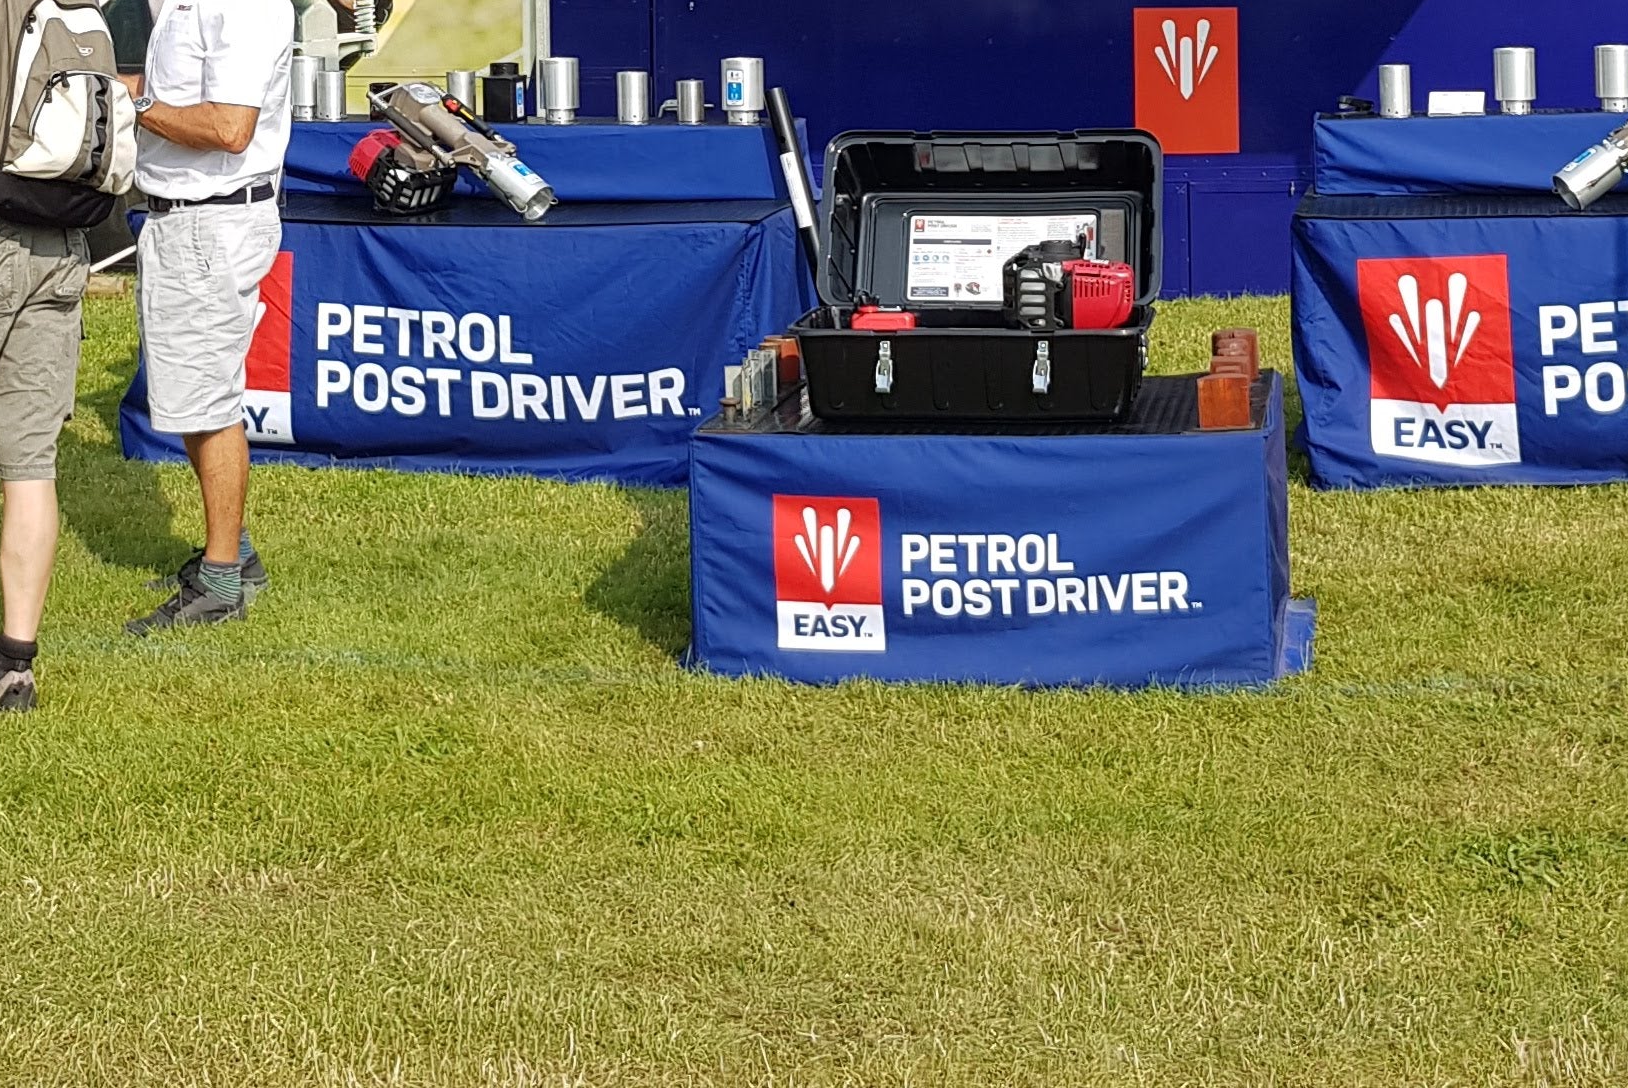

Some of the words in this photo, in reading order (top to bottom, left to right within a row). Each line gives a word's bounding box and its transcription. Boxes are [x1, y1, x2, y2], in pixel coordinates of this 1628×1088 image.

[317, 302, 533, 364] PETROL
[316, 360, 461, 417] POST
[471, 367, 686, 421] DRIVER
[1394, 416, 1493, 450] EASY
[901, 533, 1074, 572] PETROL
[902, 579, 1020, 616] POST
[1027, 571, 1189, 614] DRIVER
[794, 614, 865, 638] EASY
